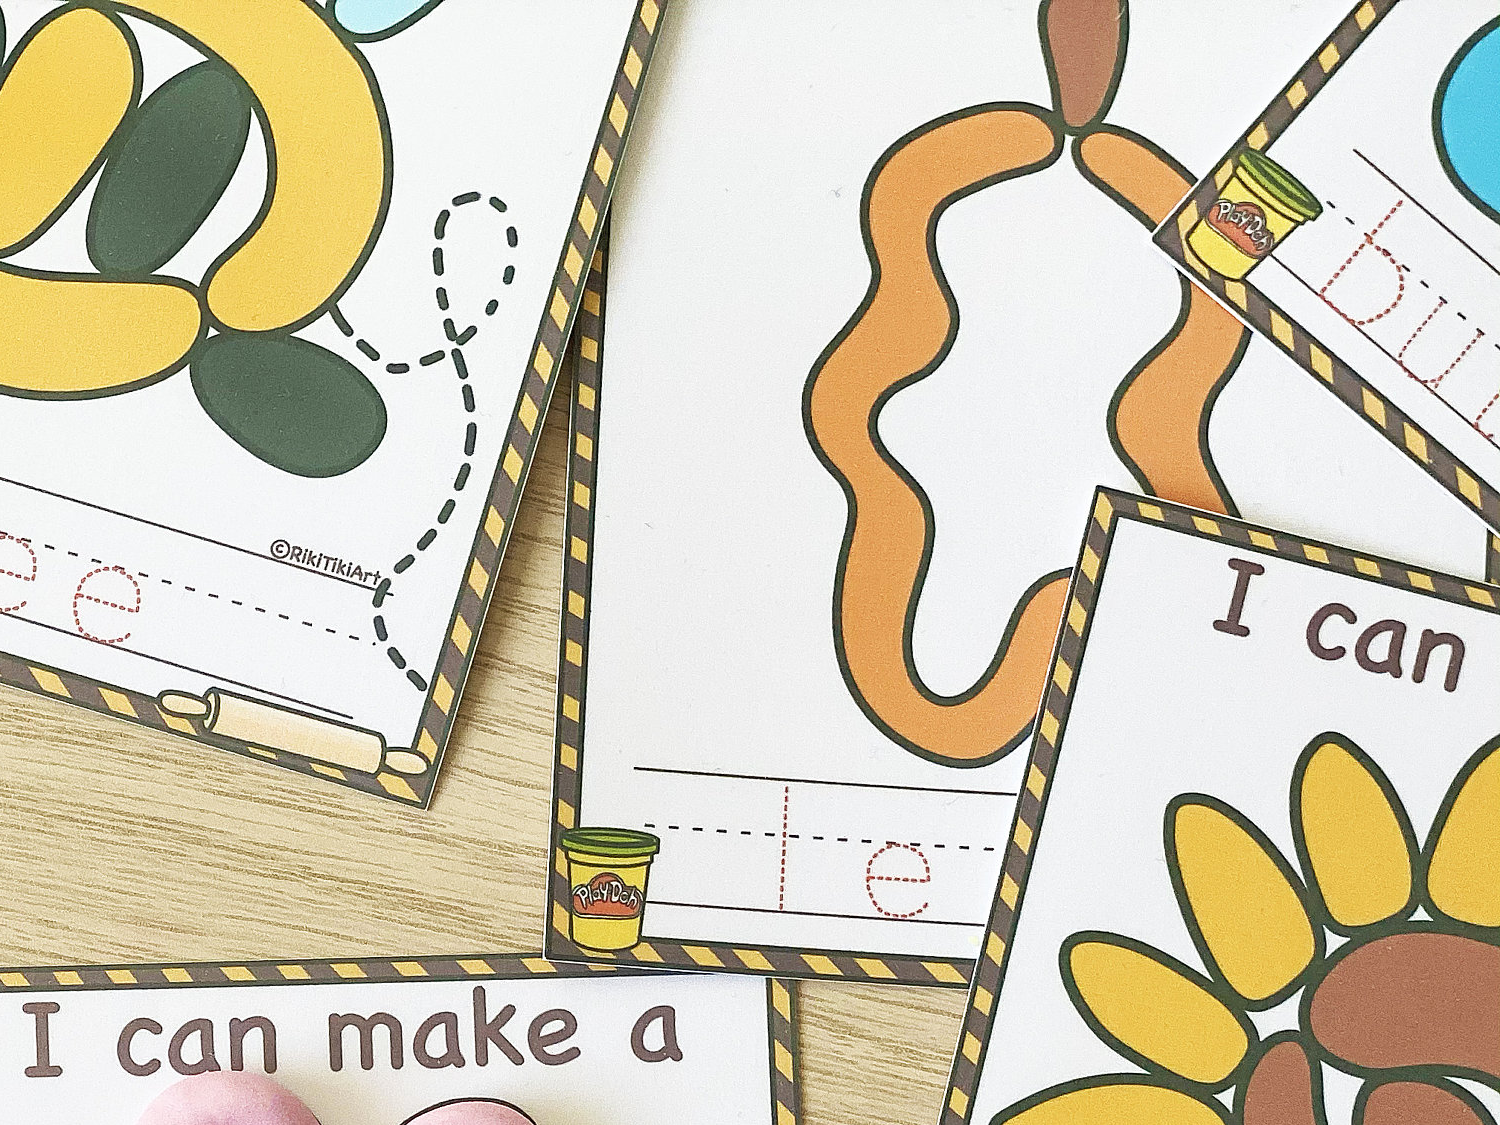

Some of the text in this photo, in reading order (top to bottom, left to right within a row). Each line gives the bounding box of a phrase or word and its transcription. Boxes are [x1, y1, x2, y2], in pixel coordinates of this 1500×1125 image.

[270, 539, 382, 585] ©RikiTikiArt
[1213, 558, 1466, 692] I can
[21, 985, 683, 1078] I can make a
